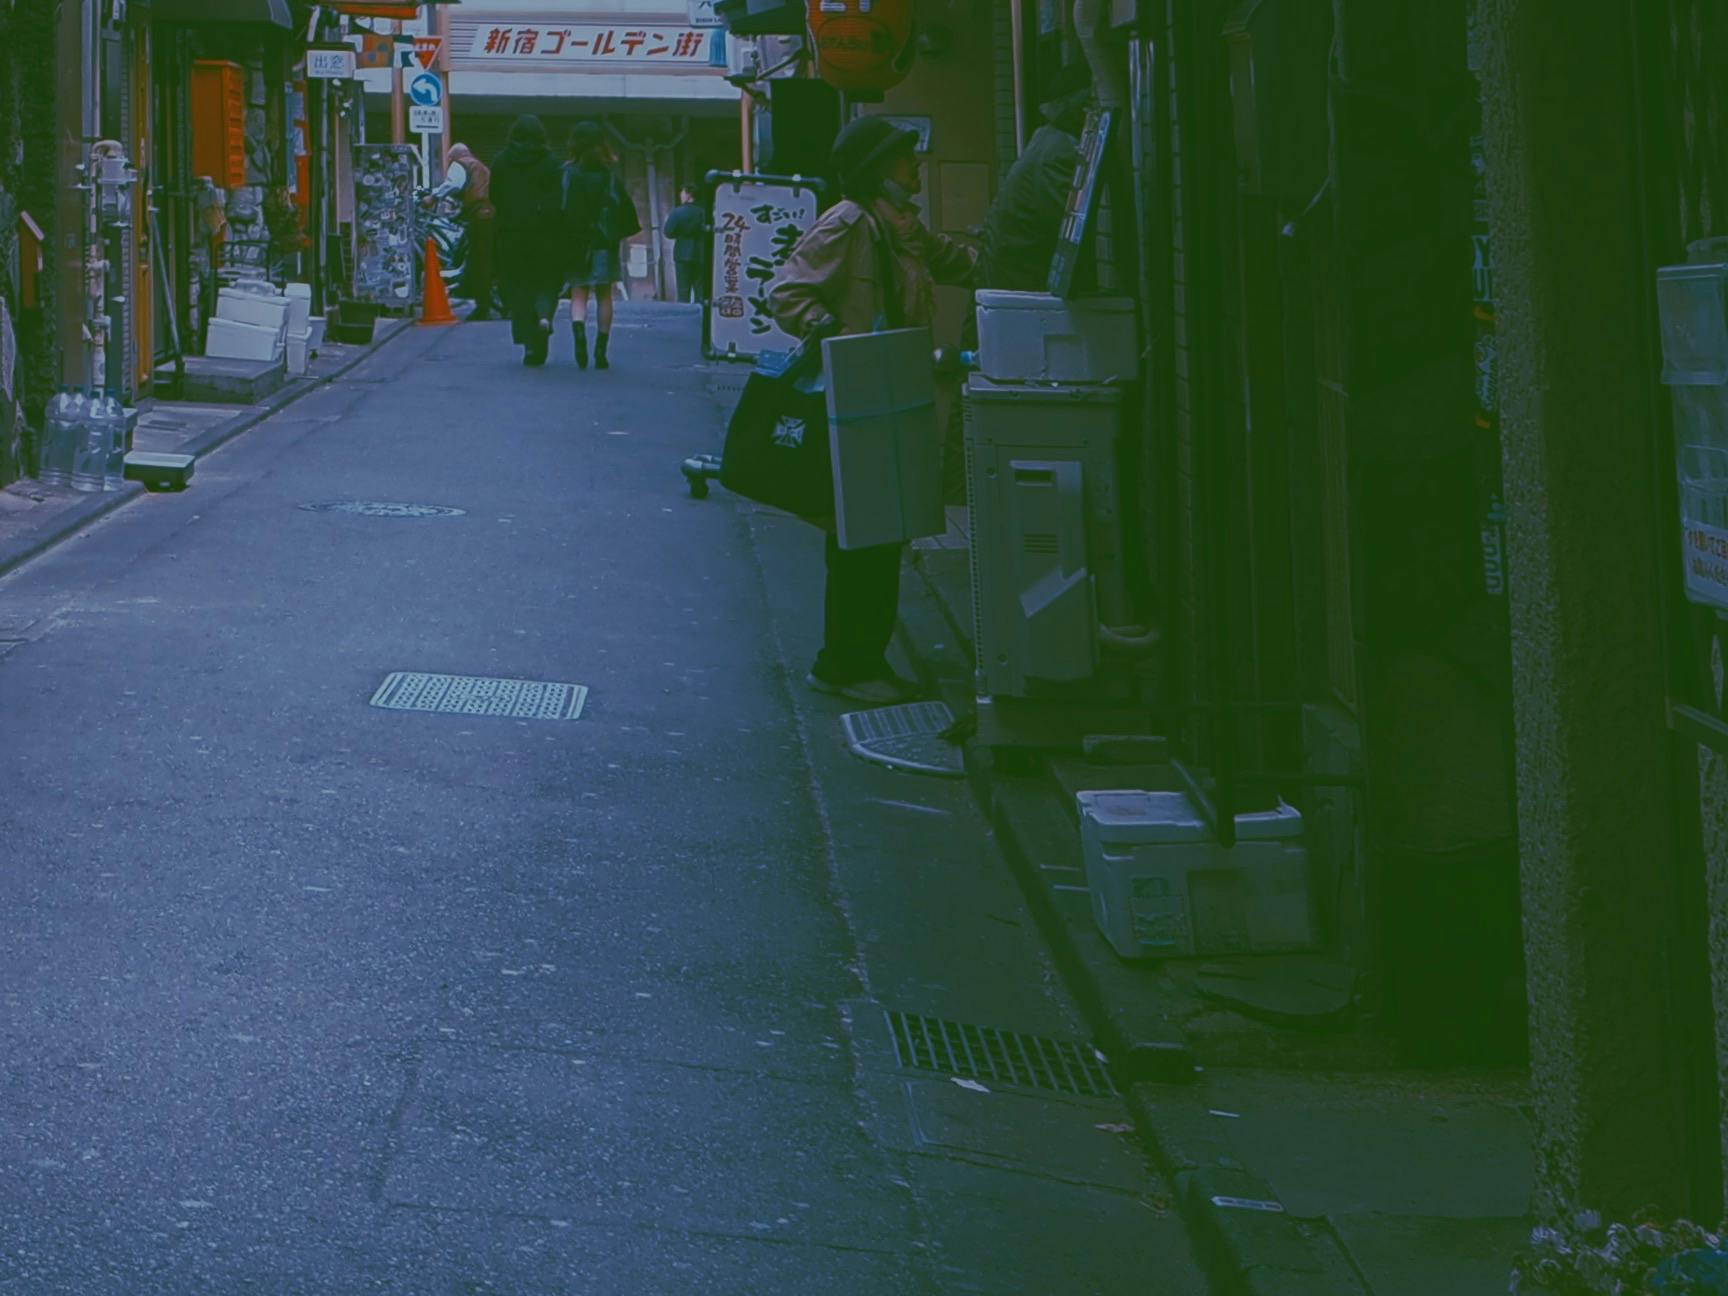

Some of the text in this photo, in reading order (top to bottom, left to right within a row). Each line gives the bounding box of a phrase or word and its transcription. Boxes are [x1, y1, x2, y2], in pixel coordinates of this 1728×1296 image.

[483, 27, 705, 57] 新宿ゴールデン街
